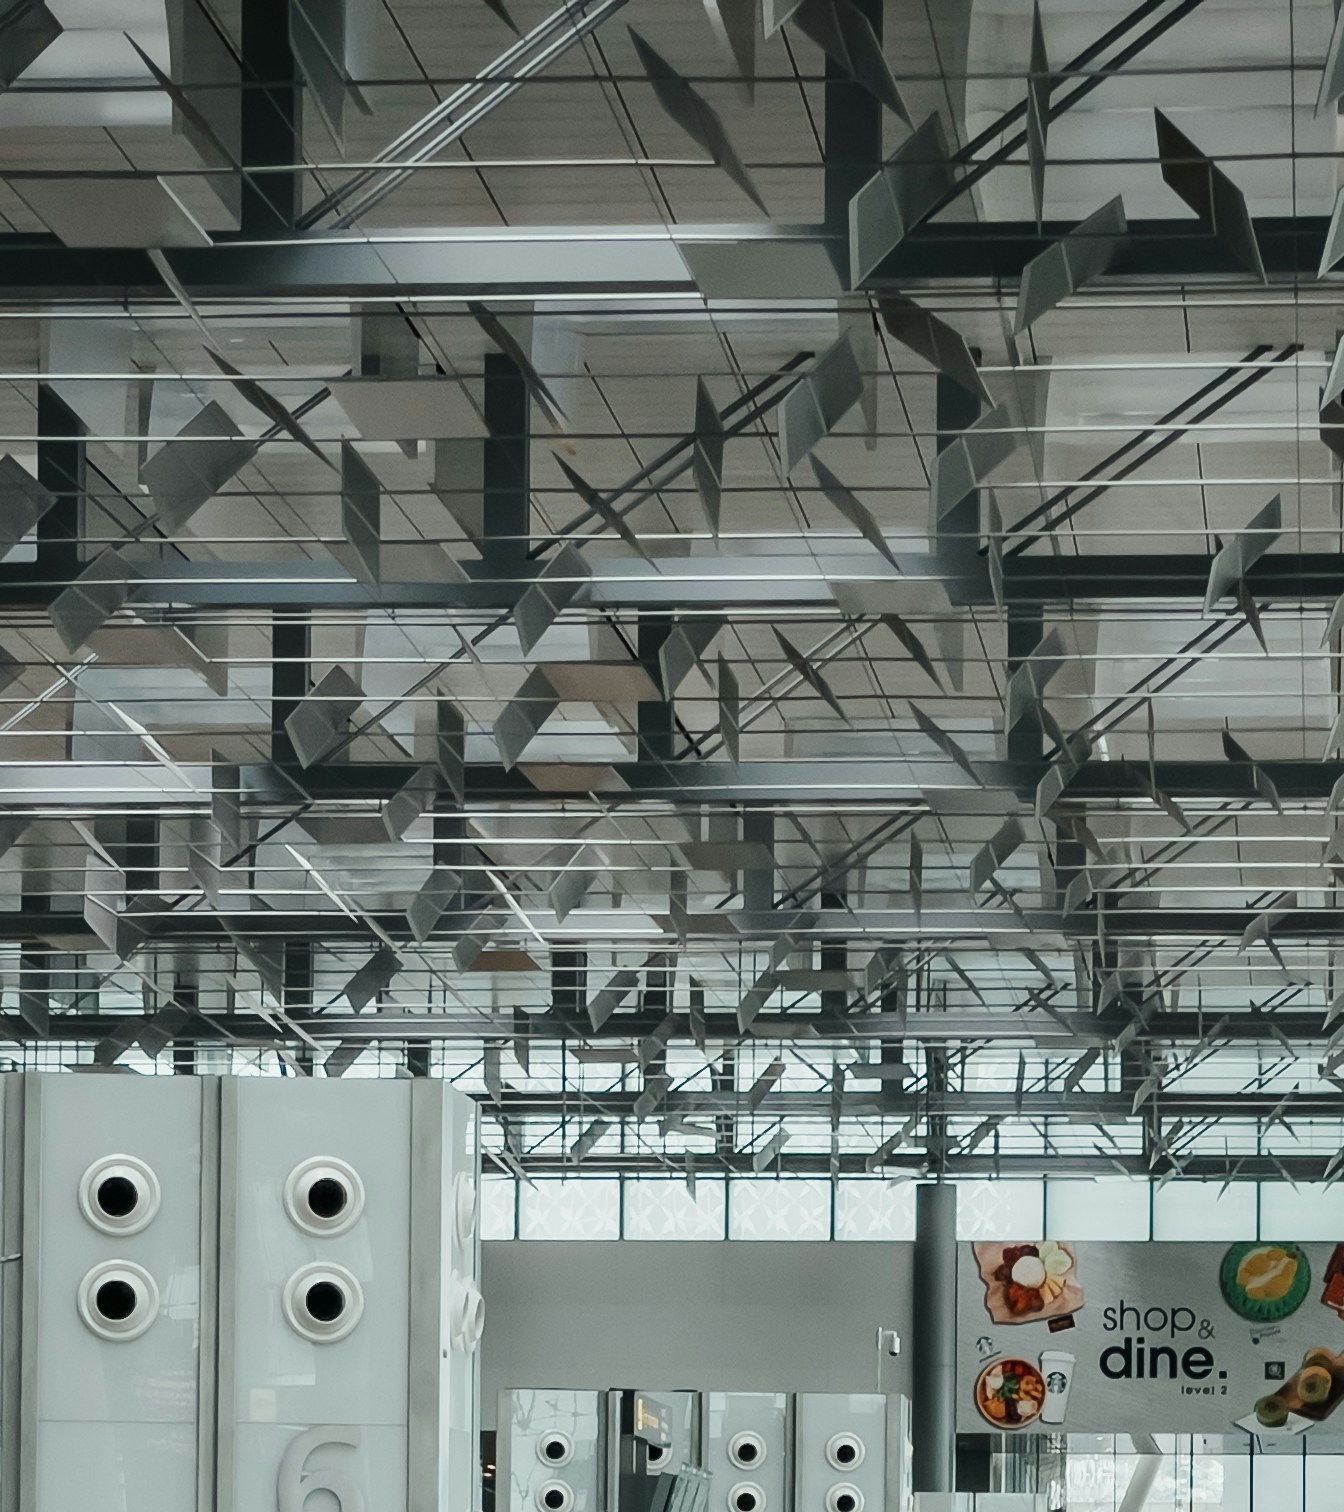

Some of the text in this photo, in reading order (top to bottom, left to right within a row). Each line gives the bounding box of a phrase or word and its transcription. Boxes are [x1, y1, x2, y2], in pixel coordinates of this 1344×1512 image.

[1103, 1300, 1196, 1338] shop
[1198, 1319, 1216, 1340] &
[1099, 1336, 1228, 1380] dine.
[1181, 1385, 1228, 1395] level 2
